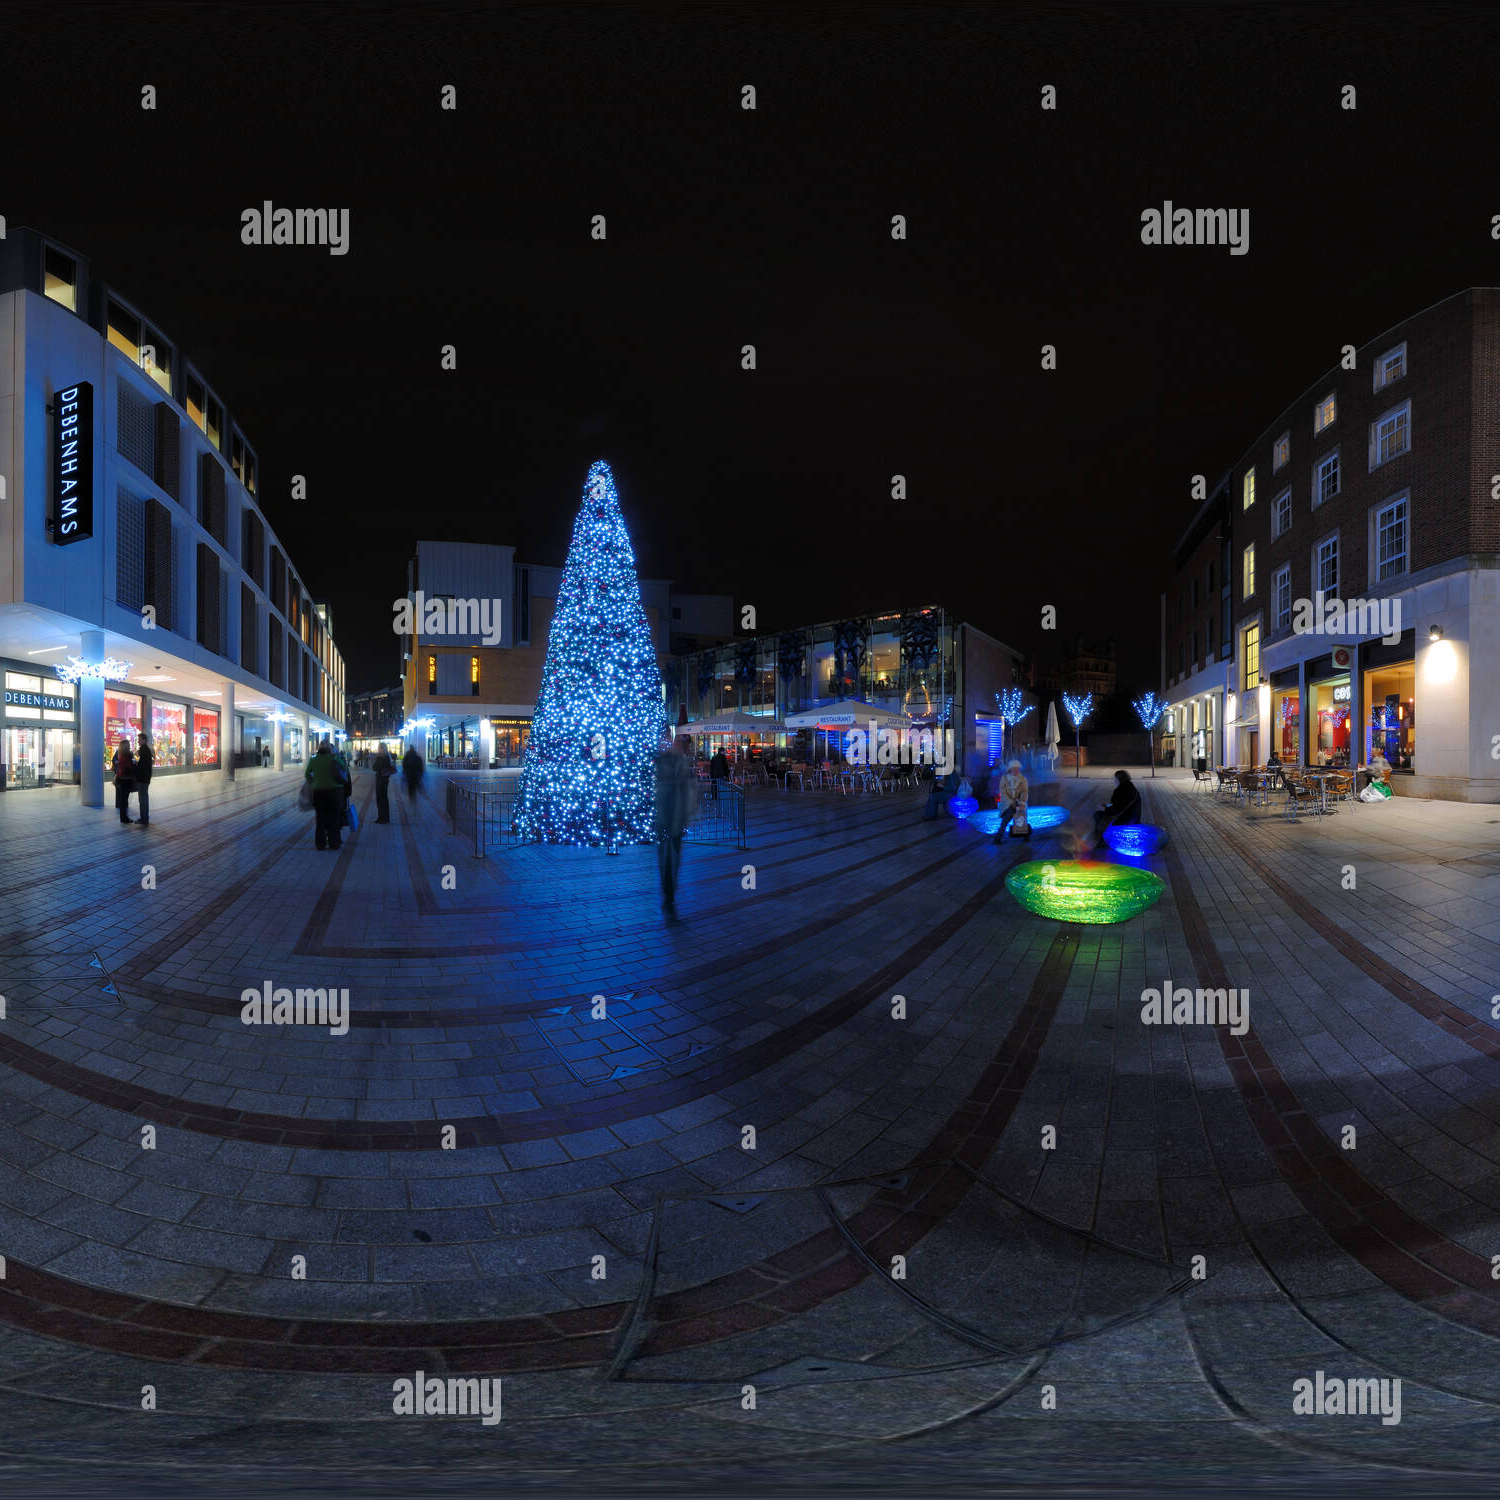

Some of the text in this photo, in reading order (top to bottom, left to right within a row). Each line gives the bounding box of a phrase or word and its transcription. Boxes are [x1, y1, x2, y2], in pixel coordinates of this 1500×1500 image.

[61, 387, 78, 535] DEBENHAMS
[4, 691, 70, 709] DEBENHAMS
[820, 715, 852, 723] RESTAURANT
[703, 724, 730, 732] RESTAURANT
